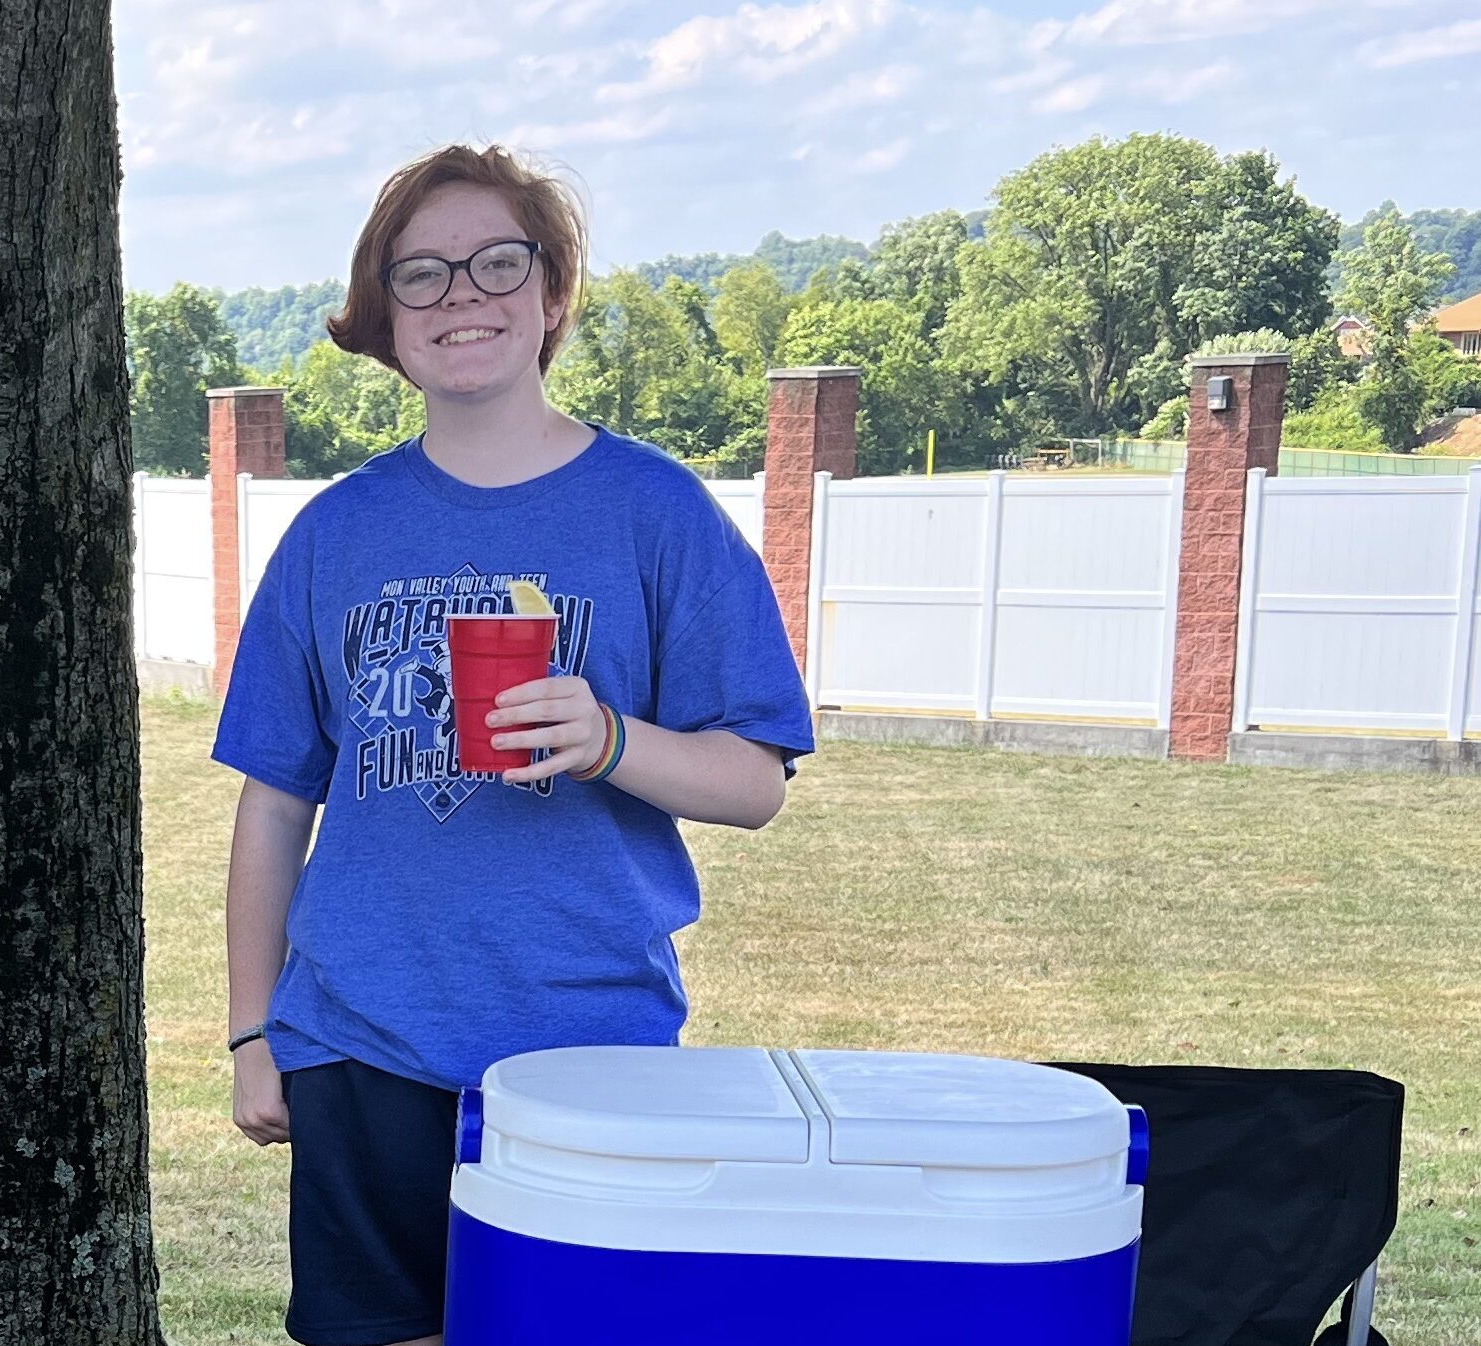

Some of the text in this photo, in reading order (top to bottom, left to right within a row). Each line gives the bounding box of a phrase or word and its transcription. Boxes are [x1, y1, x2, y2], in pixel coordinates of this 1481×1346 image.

[380, 579, 405, 597] MON
[409, 576, 447, 595] VALLEY
[452, 574, 487, 594] YOUTH
[490, 574, 514, 593] AND
[357, 727, 416, 800] FUN
[416, 749, 444, 780] AND
